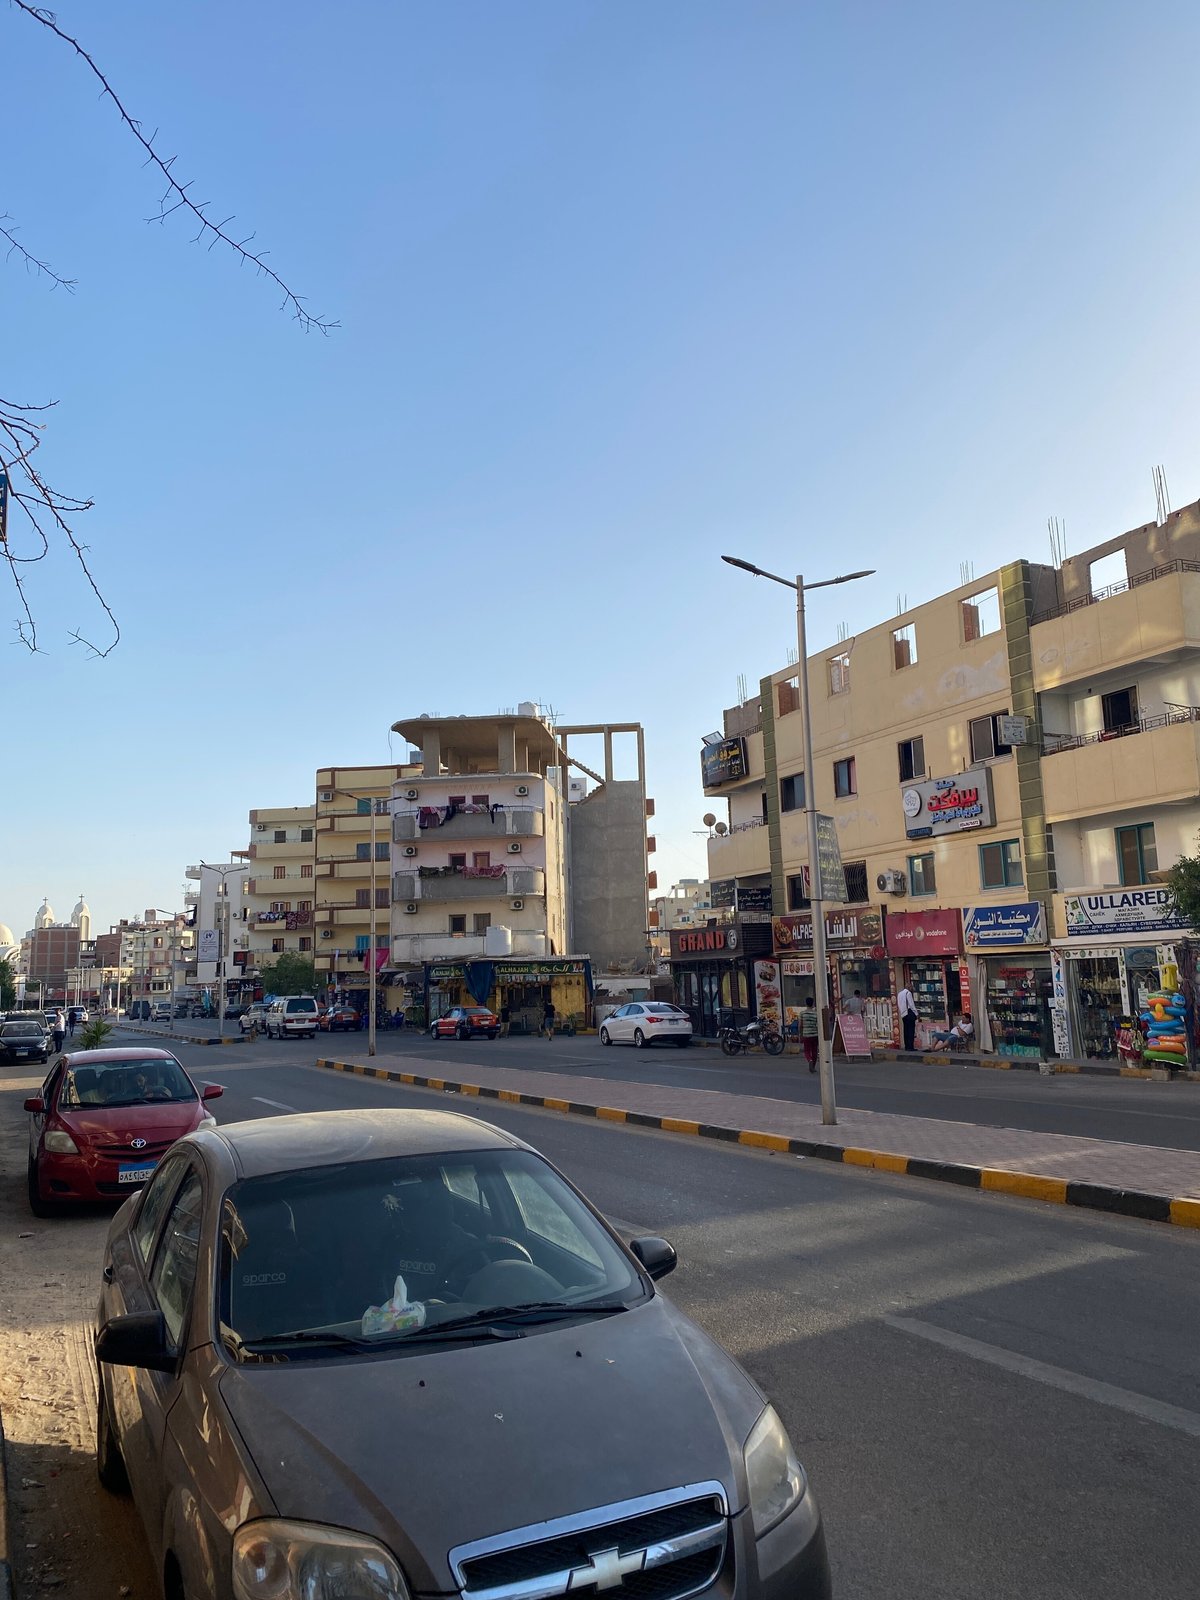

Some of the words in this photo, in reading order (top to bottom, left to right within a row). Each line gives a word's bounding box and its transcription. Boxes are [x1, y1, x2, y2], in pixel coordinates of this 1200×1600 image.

[1087, 890, 1170, 911] ULLARED
[997, 910, 1031, 928] مكتبة
[792, 923, 814, 940] ALPAS
[826, 916, 858, 941] الباشا
[925, 929, 947, 937] vodafone
[679, 930, 725, 952] GRAND
[399, 1259, 436, 1272] sparco
[242, 1271, 286, 1284] sparco
